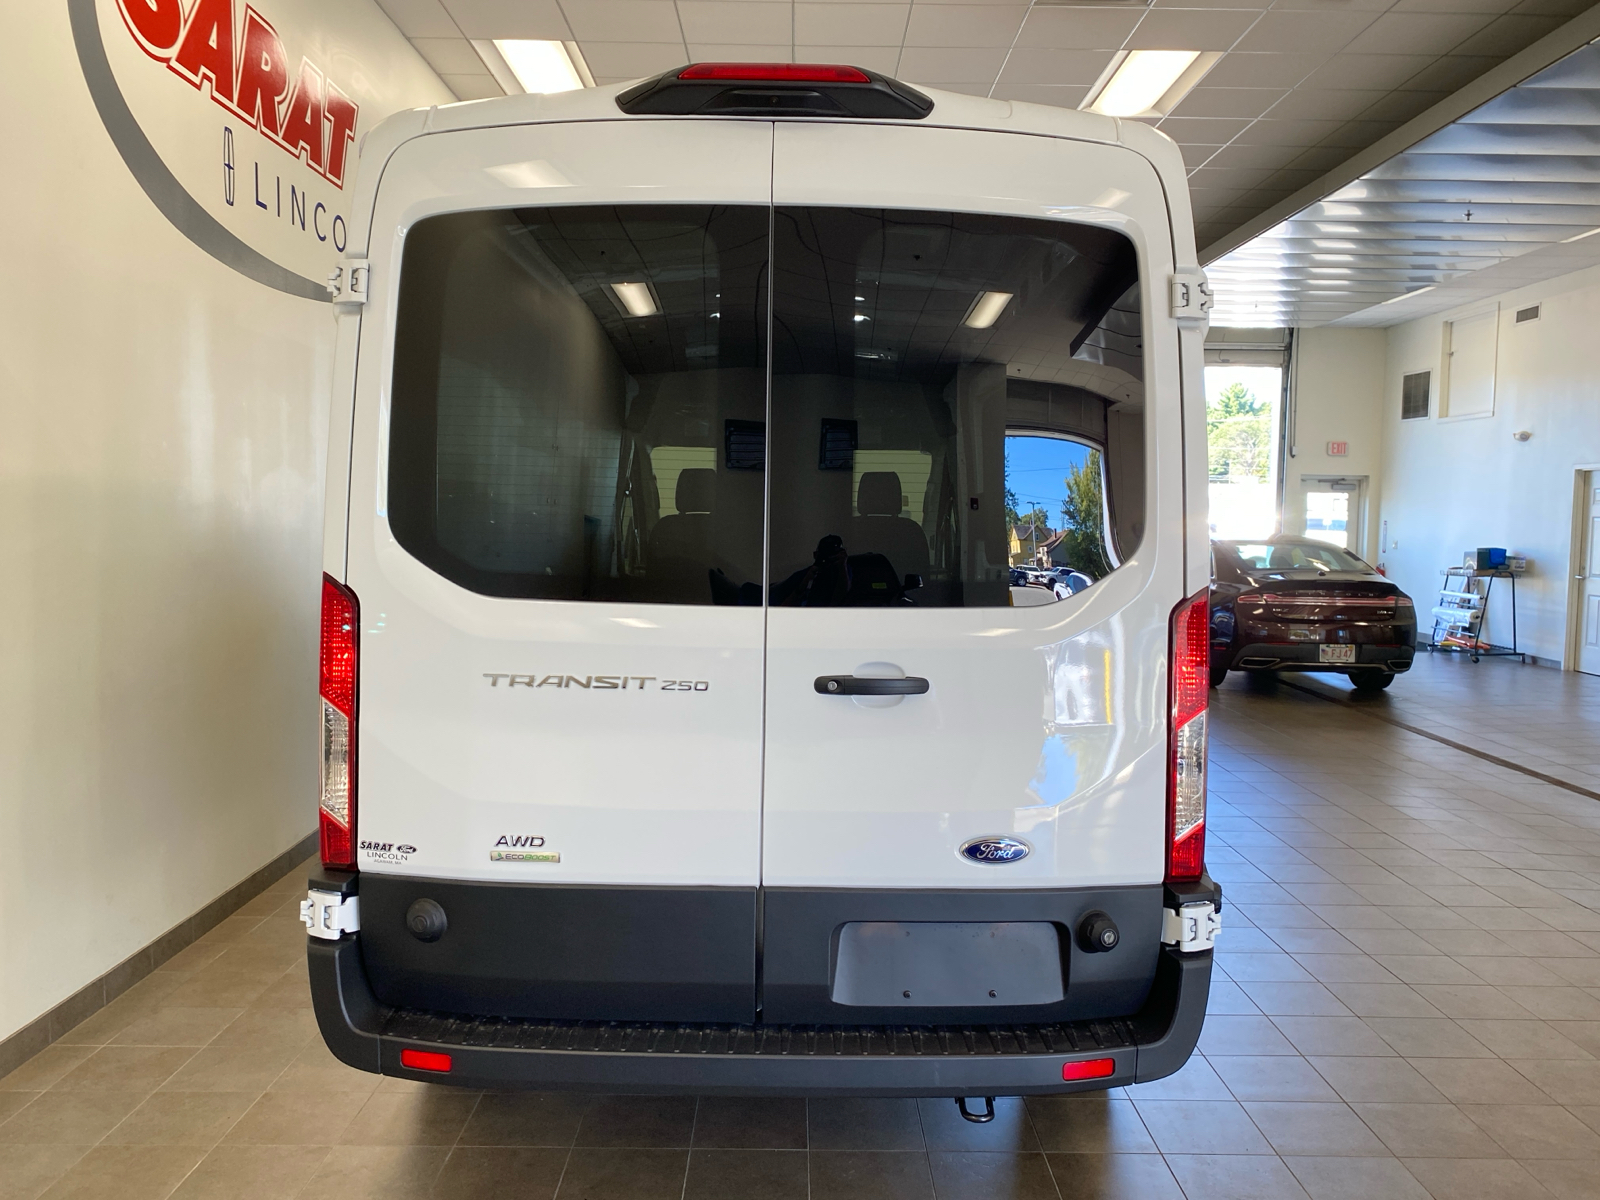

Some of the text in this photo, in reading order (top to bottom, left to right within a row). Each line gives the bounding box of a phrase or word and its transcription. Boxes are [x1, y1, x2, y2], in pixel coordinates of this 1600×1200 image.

[1331, 441, 1347, 455] EXIT
[483, 673, 709, 692] TRANSIT 250
[360, 840, 394, 852] SARAT
[494, 835, 545, 848] AWD
[366, 851, 408, 861] LINCOLN
[976, 842, 1016, 859] Ford
